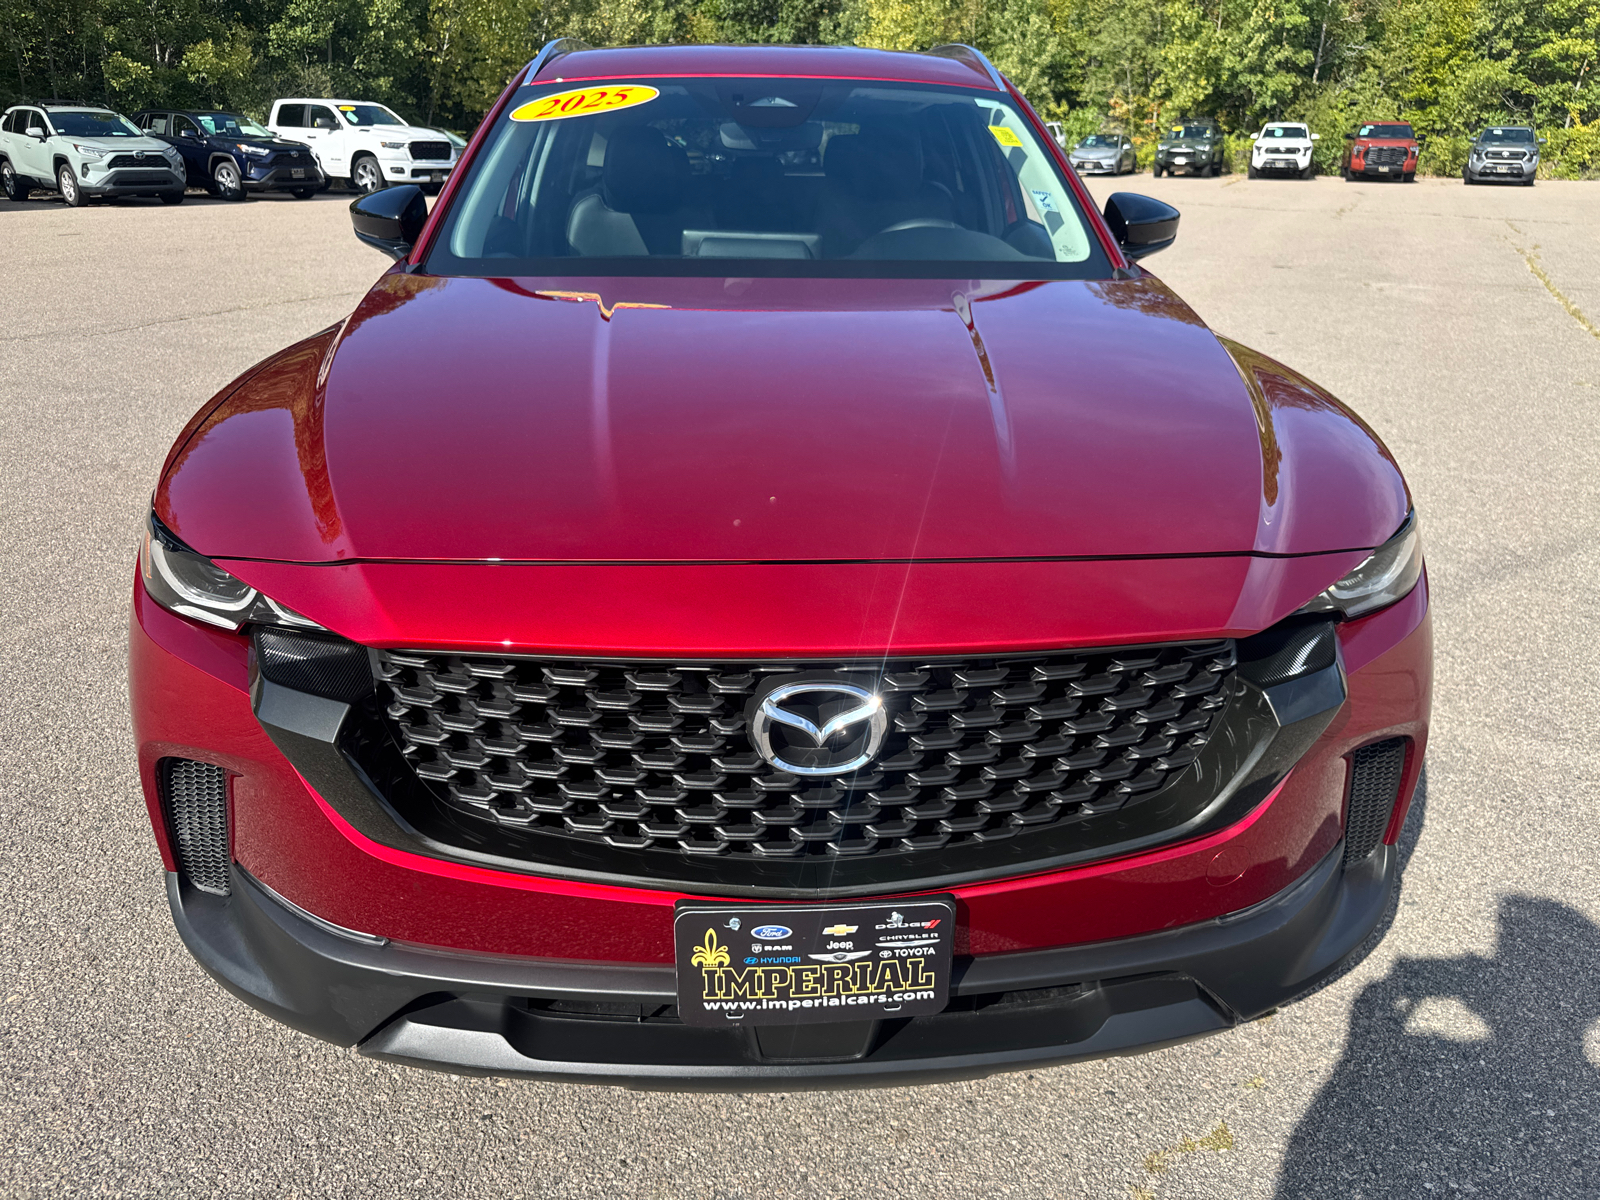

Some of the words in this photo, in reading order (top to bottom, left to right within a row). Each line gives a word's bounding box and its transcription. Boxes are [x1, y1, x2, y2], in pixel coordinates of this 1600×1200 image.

[534, 88, 634, 118] 2025
[875, 921, 931, 930] DODGE
[760, 928, 783, 937] Ford
[879, 932, 939, 940] CHRYSLER
[826, 941, 853, 950] Jeep
[894, 947, 936, 957] TOYOTA
[760, 956, 801, 964] HYUNDAI
[702, 957, 935, 1000] IMPERIAL
[703, 990, 935, 1011] www.imperialcars.com
